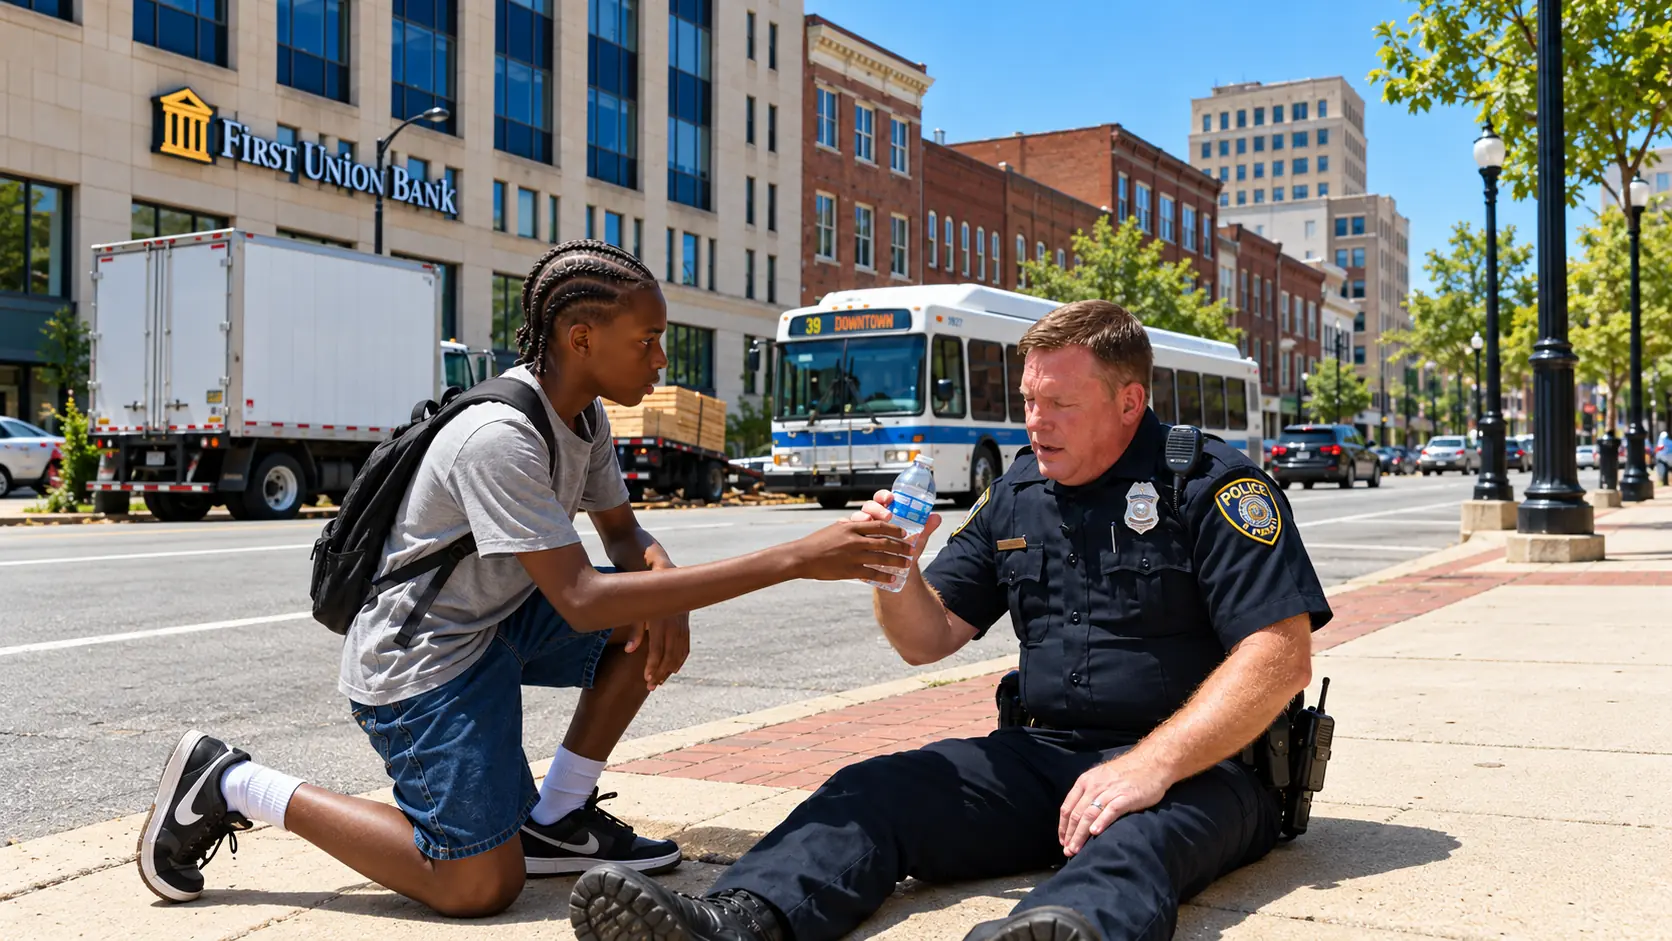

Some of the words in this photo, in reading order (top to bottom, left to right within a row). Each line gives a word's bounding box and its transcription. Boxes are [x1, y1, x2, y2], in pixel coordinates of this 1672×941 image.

[805, 317, 821, 335] 39
[834, 313, 893, 331] DOWNTOWN
[1220, 482, 1267, 507] POLICE
